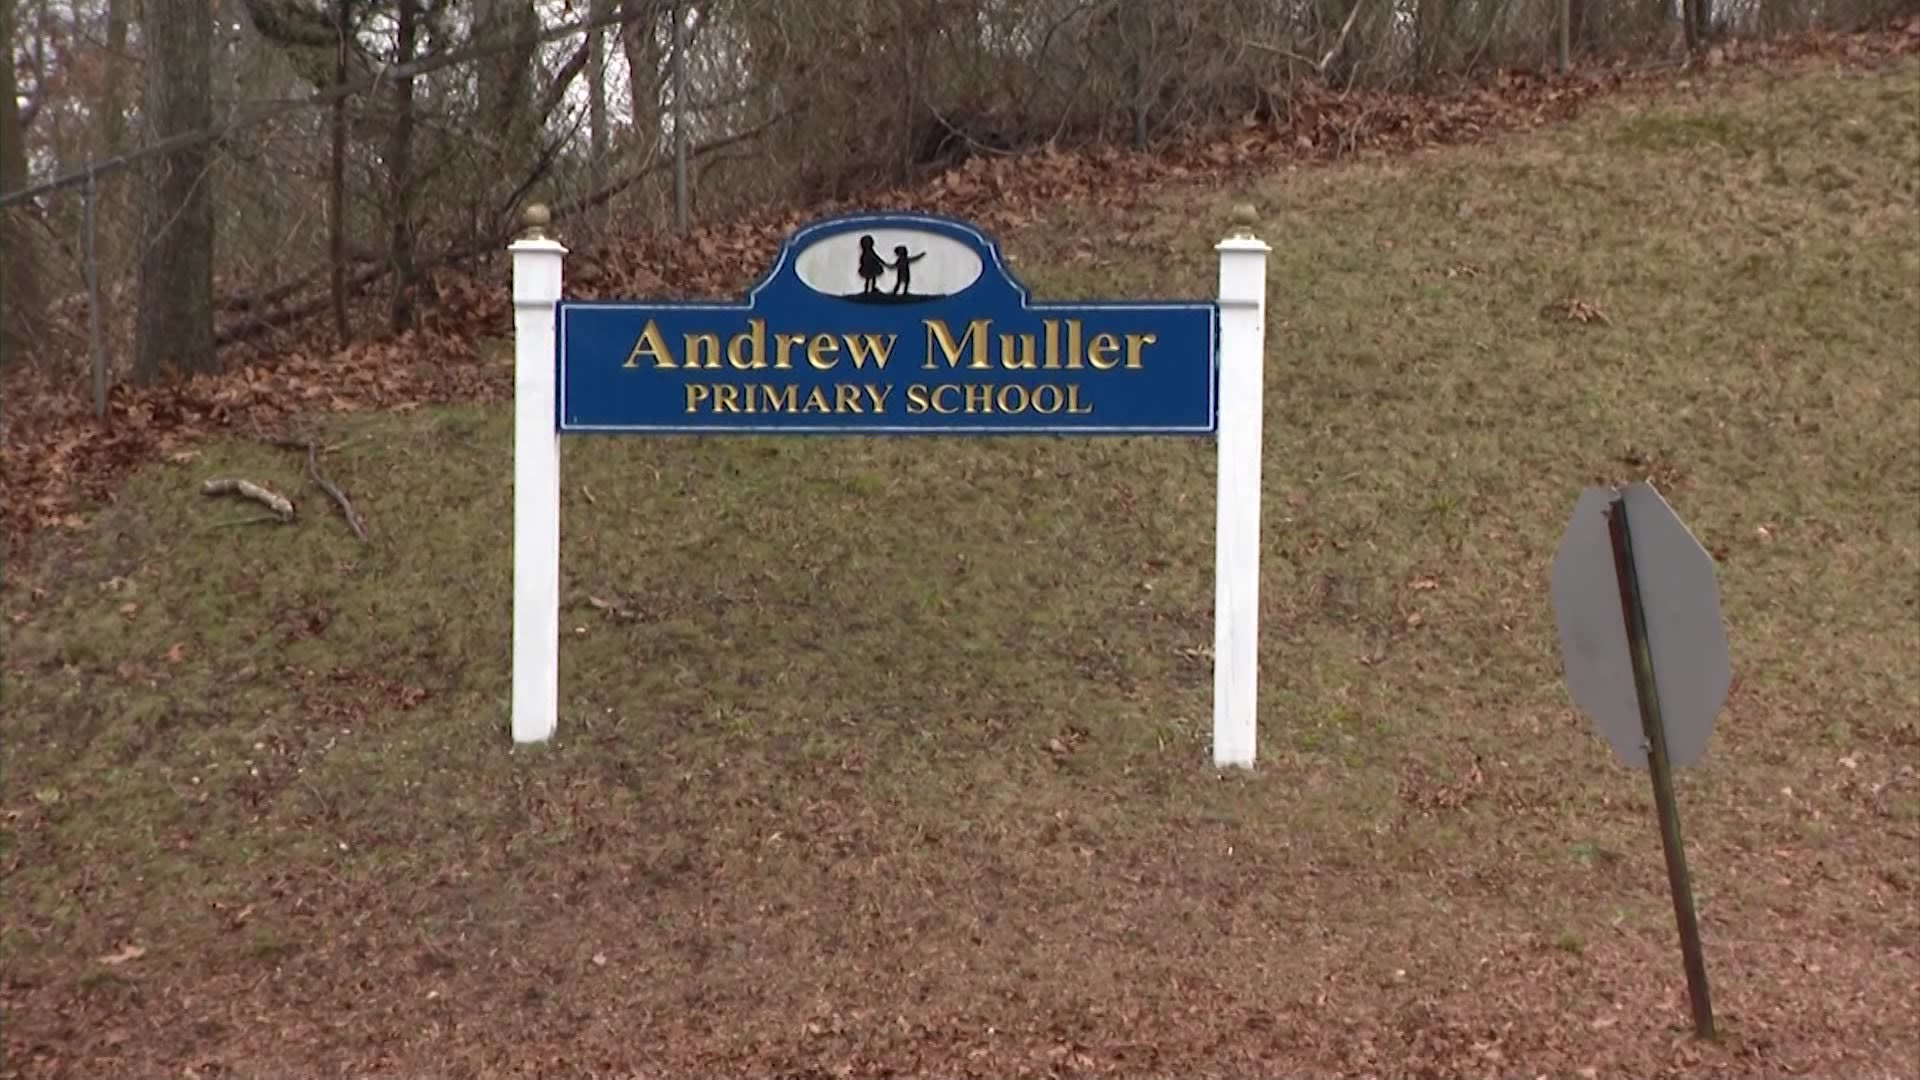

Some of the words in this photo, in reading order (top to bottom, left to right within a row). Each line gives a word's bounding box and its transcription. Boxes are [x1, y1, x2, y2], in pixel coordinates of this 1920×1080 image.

[622, 318, 898, 370] Andrew
[923, 318, 1157, 370] Muller
[685, 383, 892, 415] PRIMARY
[905, 383, 1092, 414] SCHOOL
